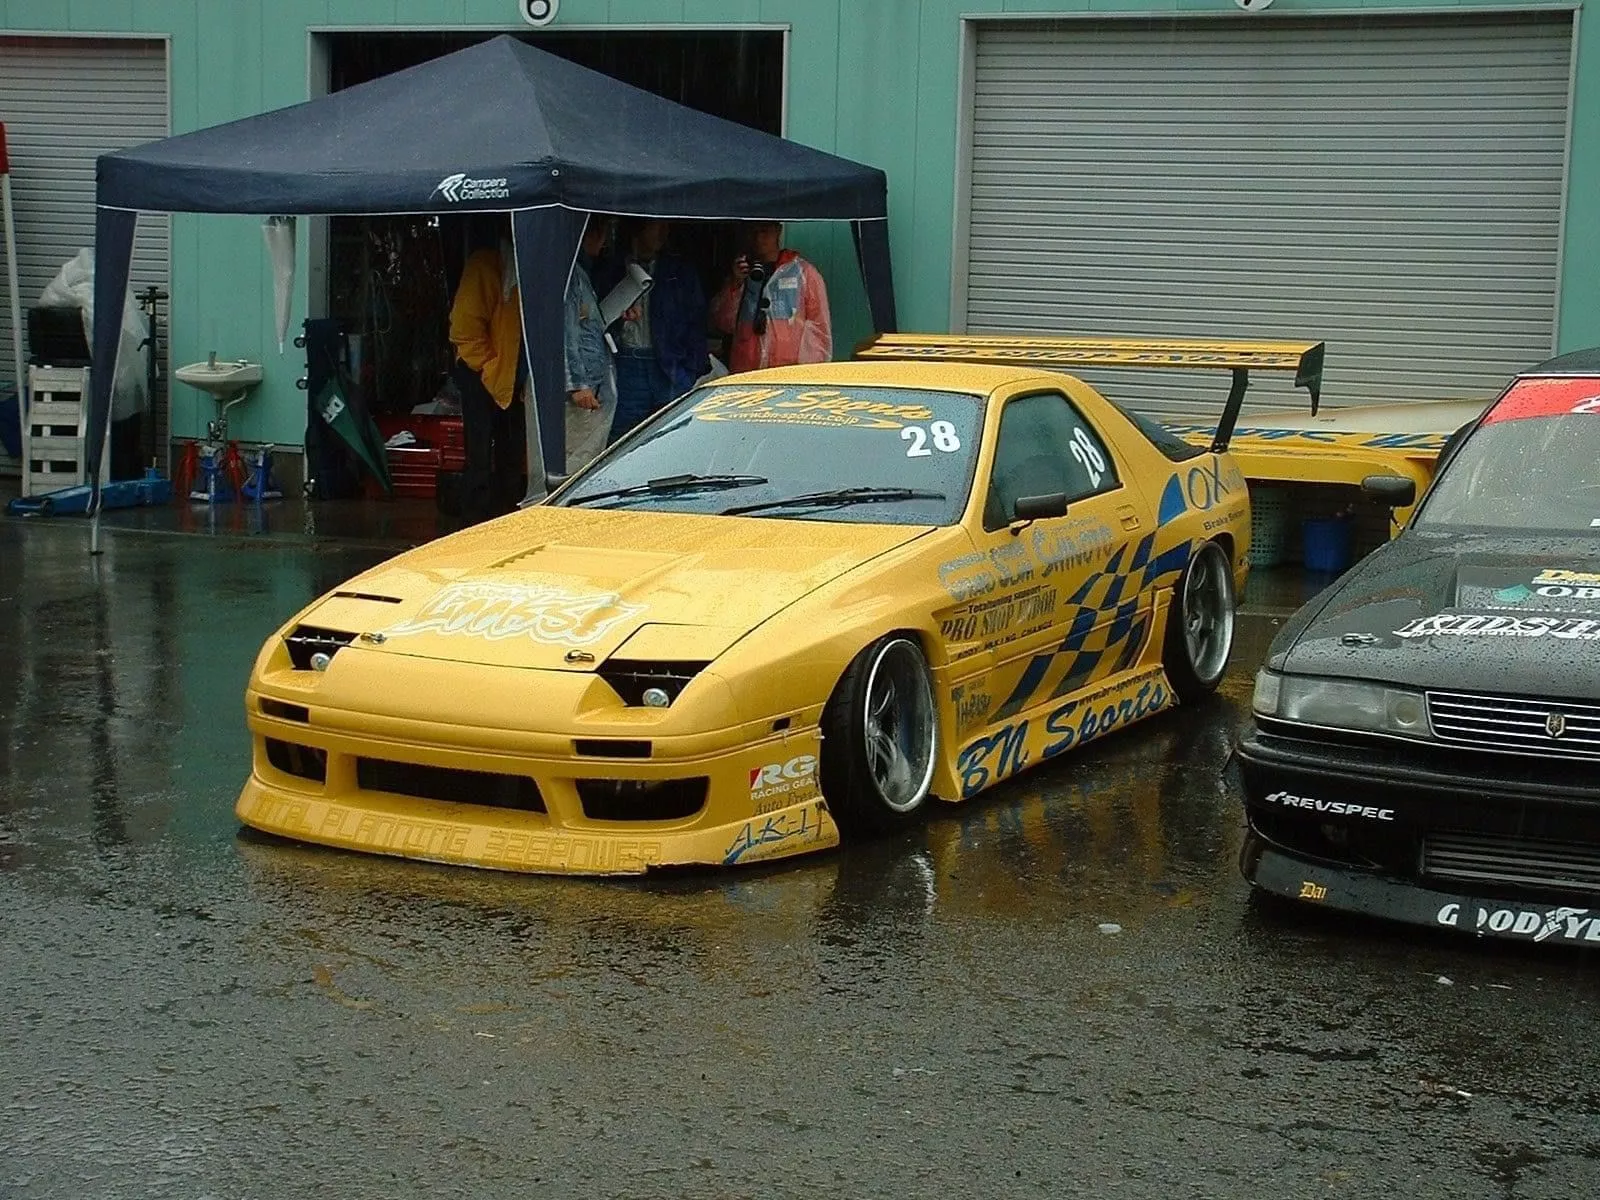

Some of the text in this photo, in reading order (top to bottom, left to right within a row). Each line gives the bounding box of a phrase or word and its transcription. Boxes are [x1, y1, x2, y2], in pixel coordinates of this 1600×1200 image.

[460, 188, 509, 200] Collection
[462, 178, 507, 188] Campers
[901, 420, 961, 457] 28
[1069, 427, 1105, 489] 28
[941, 614, 977, 641] PRO
[1043, 681, 1169, 759] Sports
[752, 755, 817, 790] RG
[751, 782, 791, 800] RACING
[1284, 794, 1395, 821] REVSPEC
[320, 804, 472, 858] PLANNING
